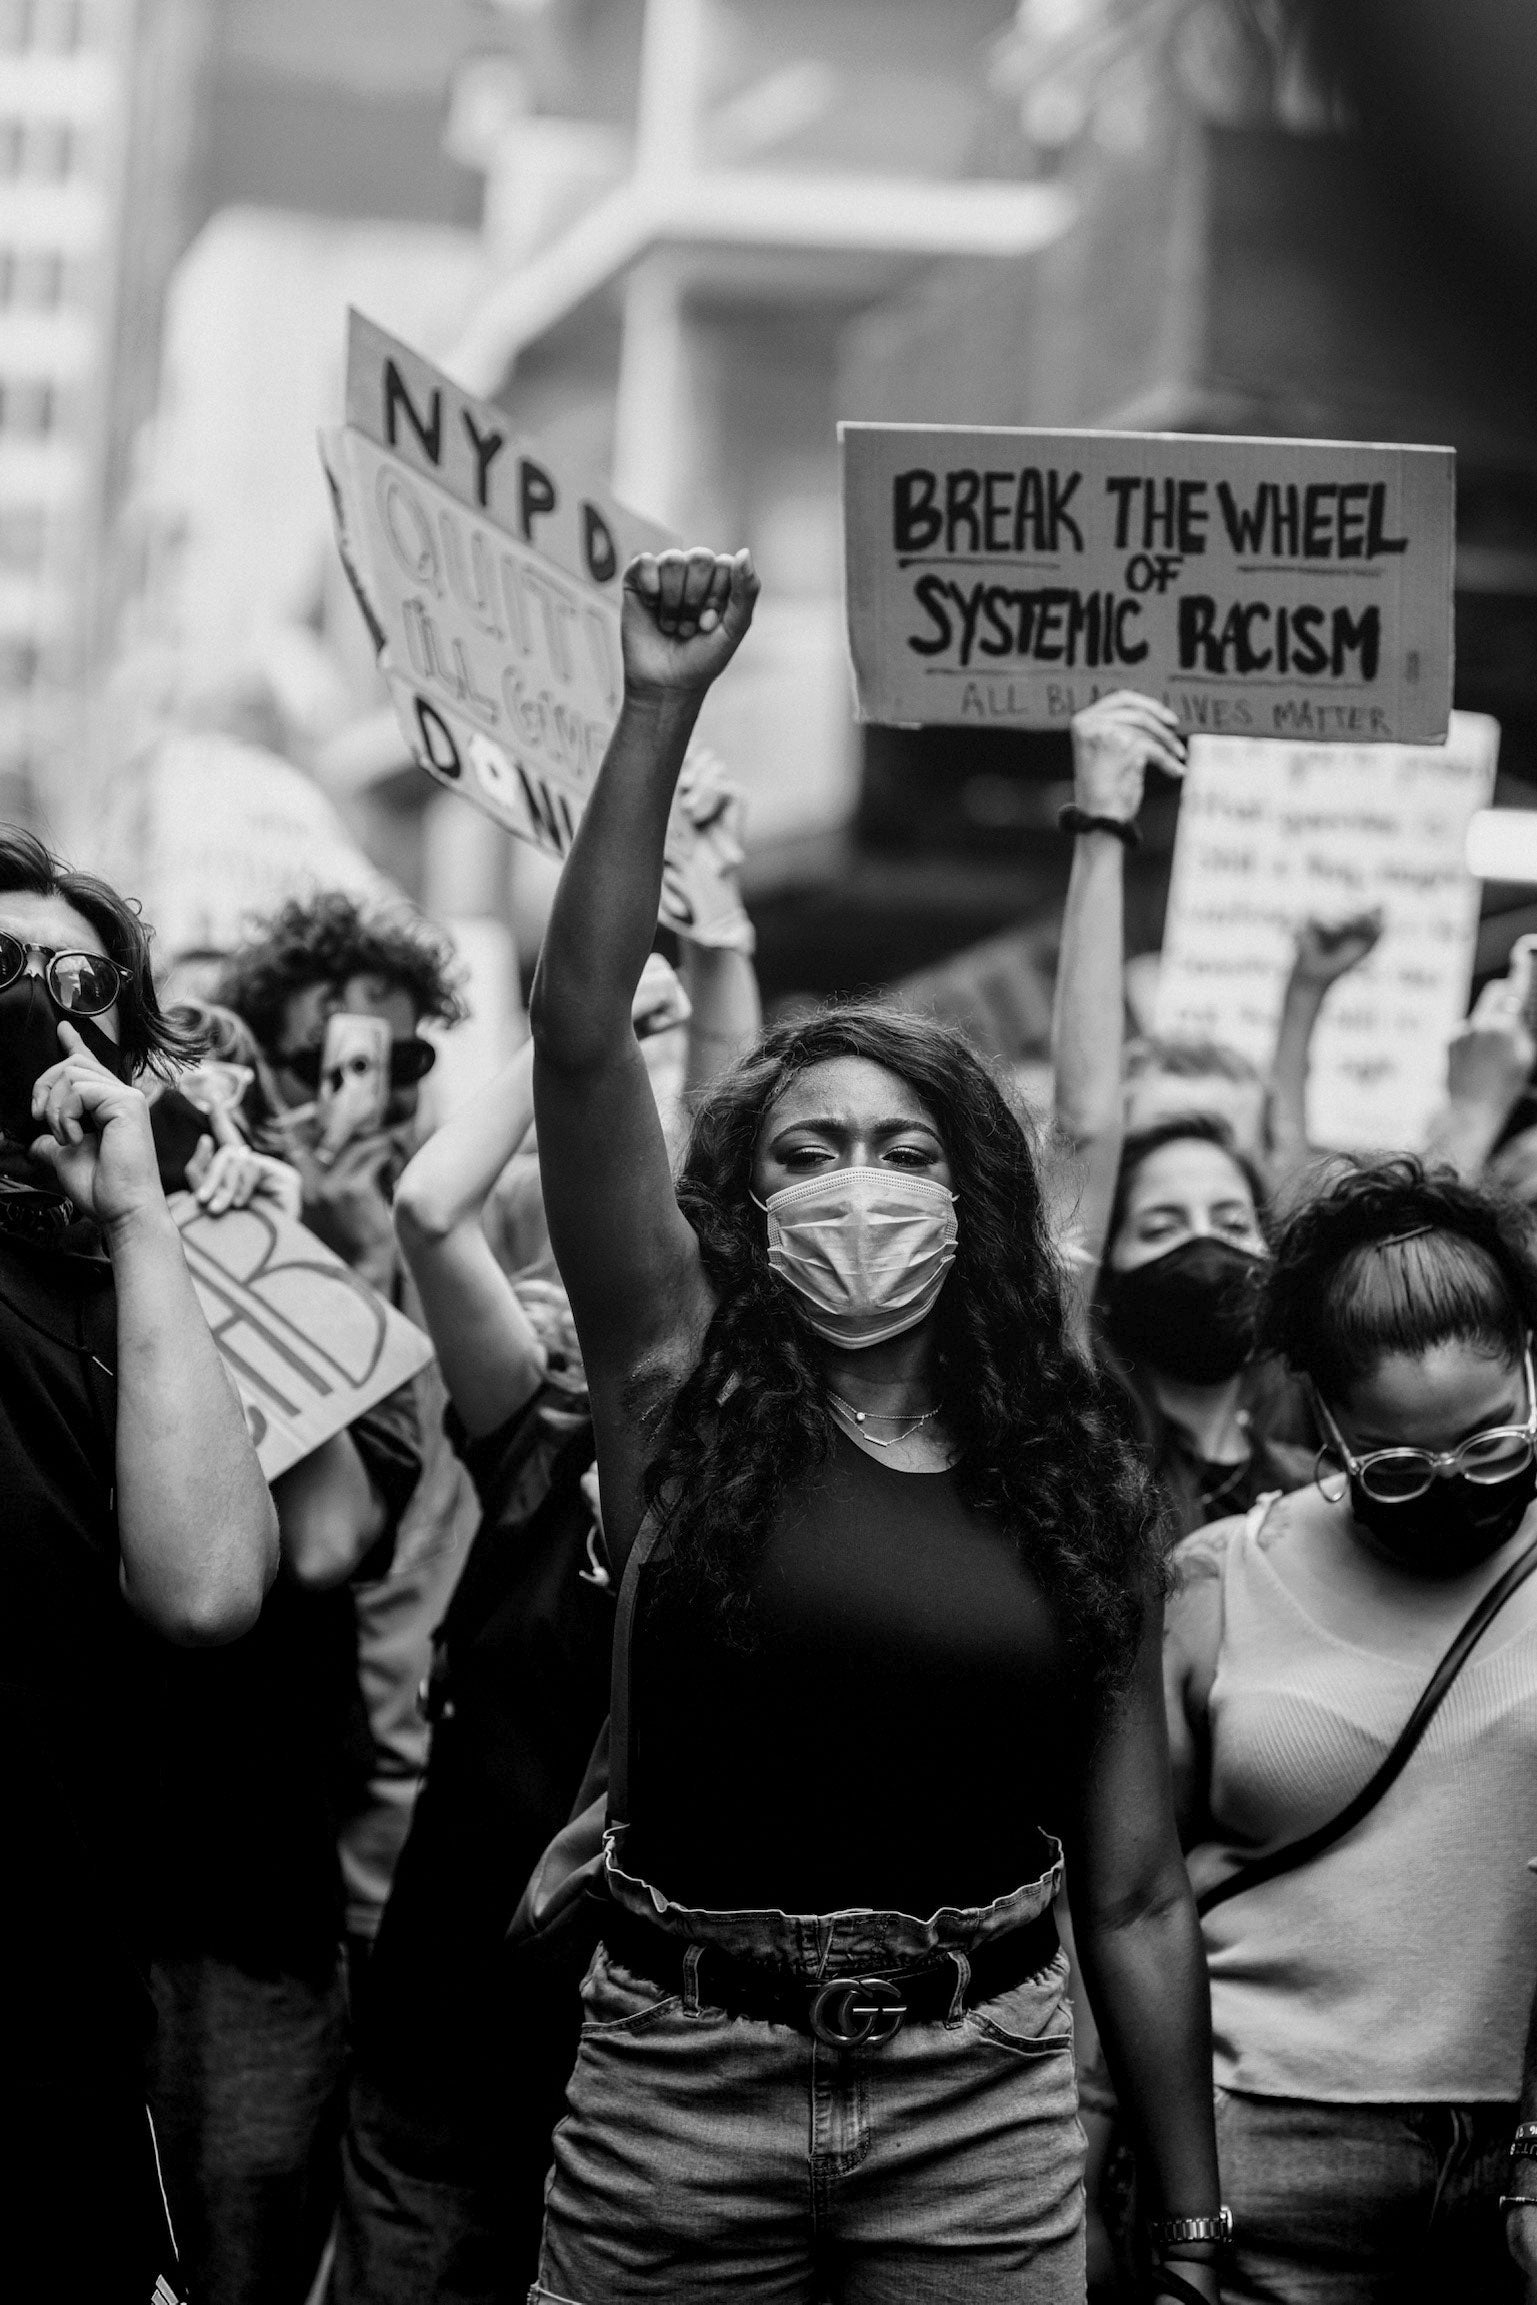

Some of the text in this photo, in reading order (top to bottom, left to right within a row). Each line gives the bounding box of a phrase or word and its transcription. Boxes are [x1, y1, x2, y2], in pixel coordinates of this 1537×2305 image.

[383, 356, 619, 585] NYPD
[893, 467, 1409, 560] BREAK THE WHEEL
[1125, 553, 1184, 594] OF
[907, 574, 1381, 682] SYSTEMIC RACISM
[960, 680, 1030, 718] ALL
[1274, 700, 1396, 736] MATTER
